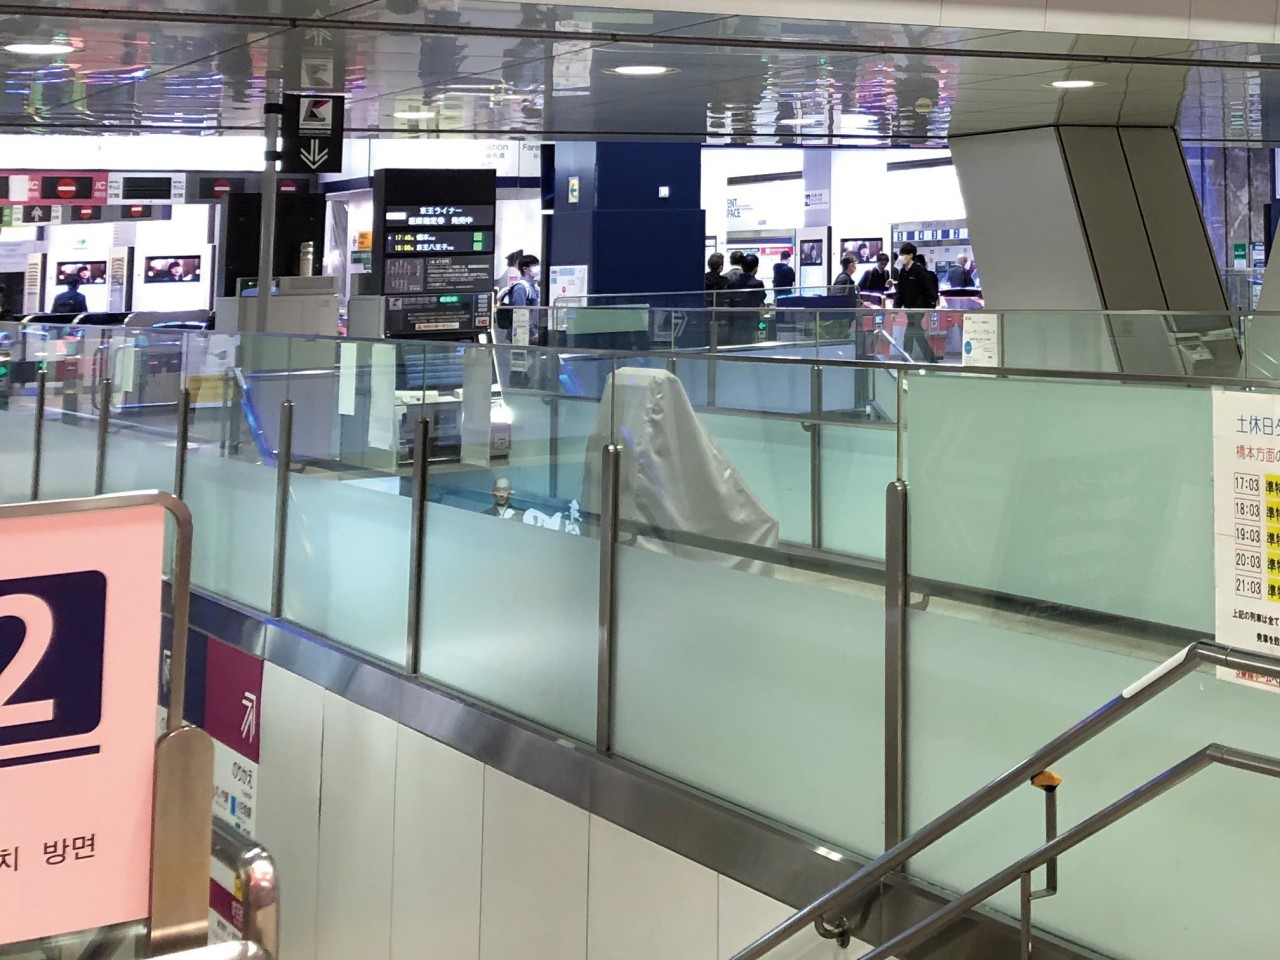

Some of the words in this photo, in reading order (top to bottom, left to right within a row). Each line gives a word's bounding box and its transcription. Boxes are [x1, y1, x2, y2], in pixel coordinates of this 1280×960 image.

[1235, 476, 1260, 492] 17:03
[1235, 502, 1260, 518] 18:03
[1236, 527, 1260, 543] 19:03
[1236, 553, 1261, 569] 20:03
[1236, 578, 1261, 594] 21:03
[43, 833, 96, 866] 방면
